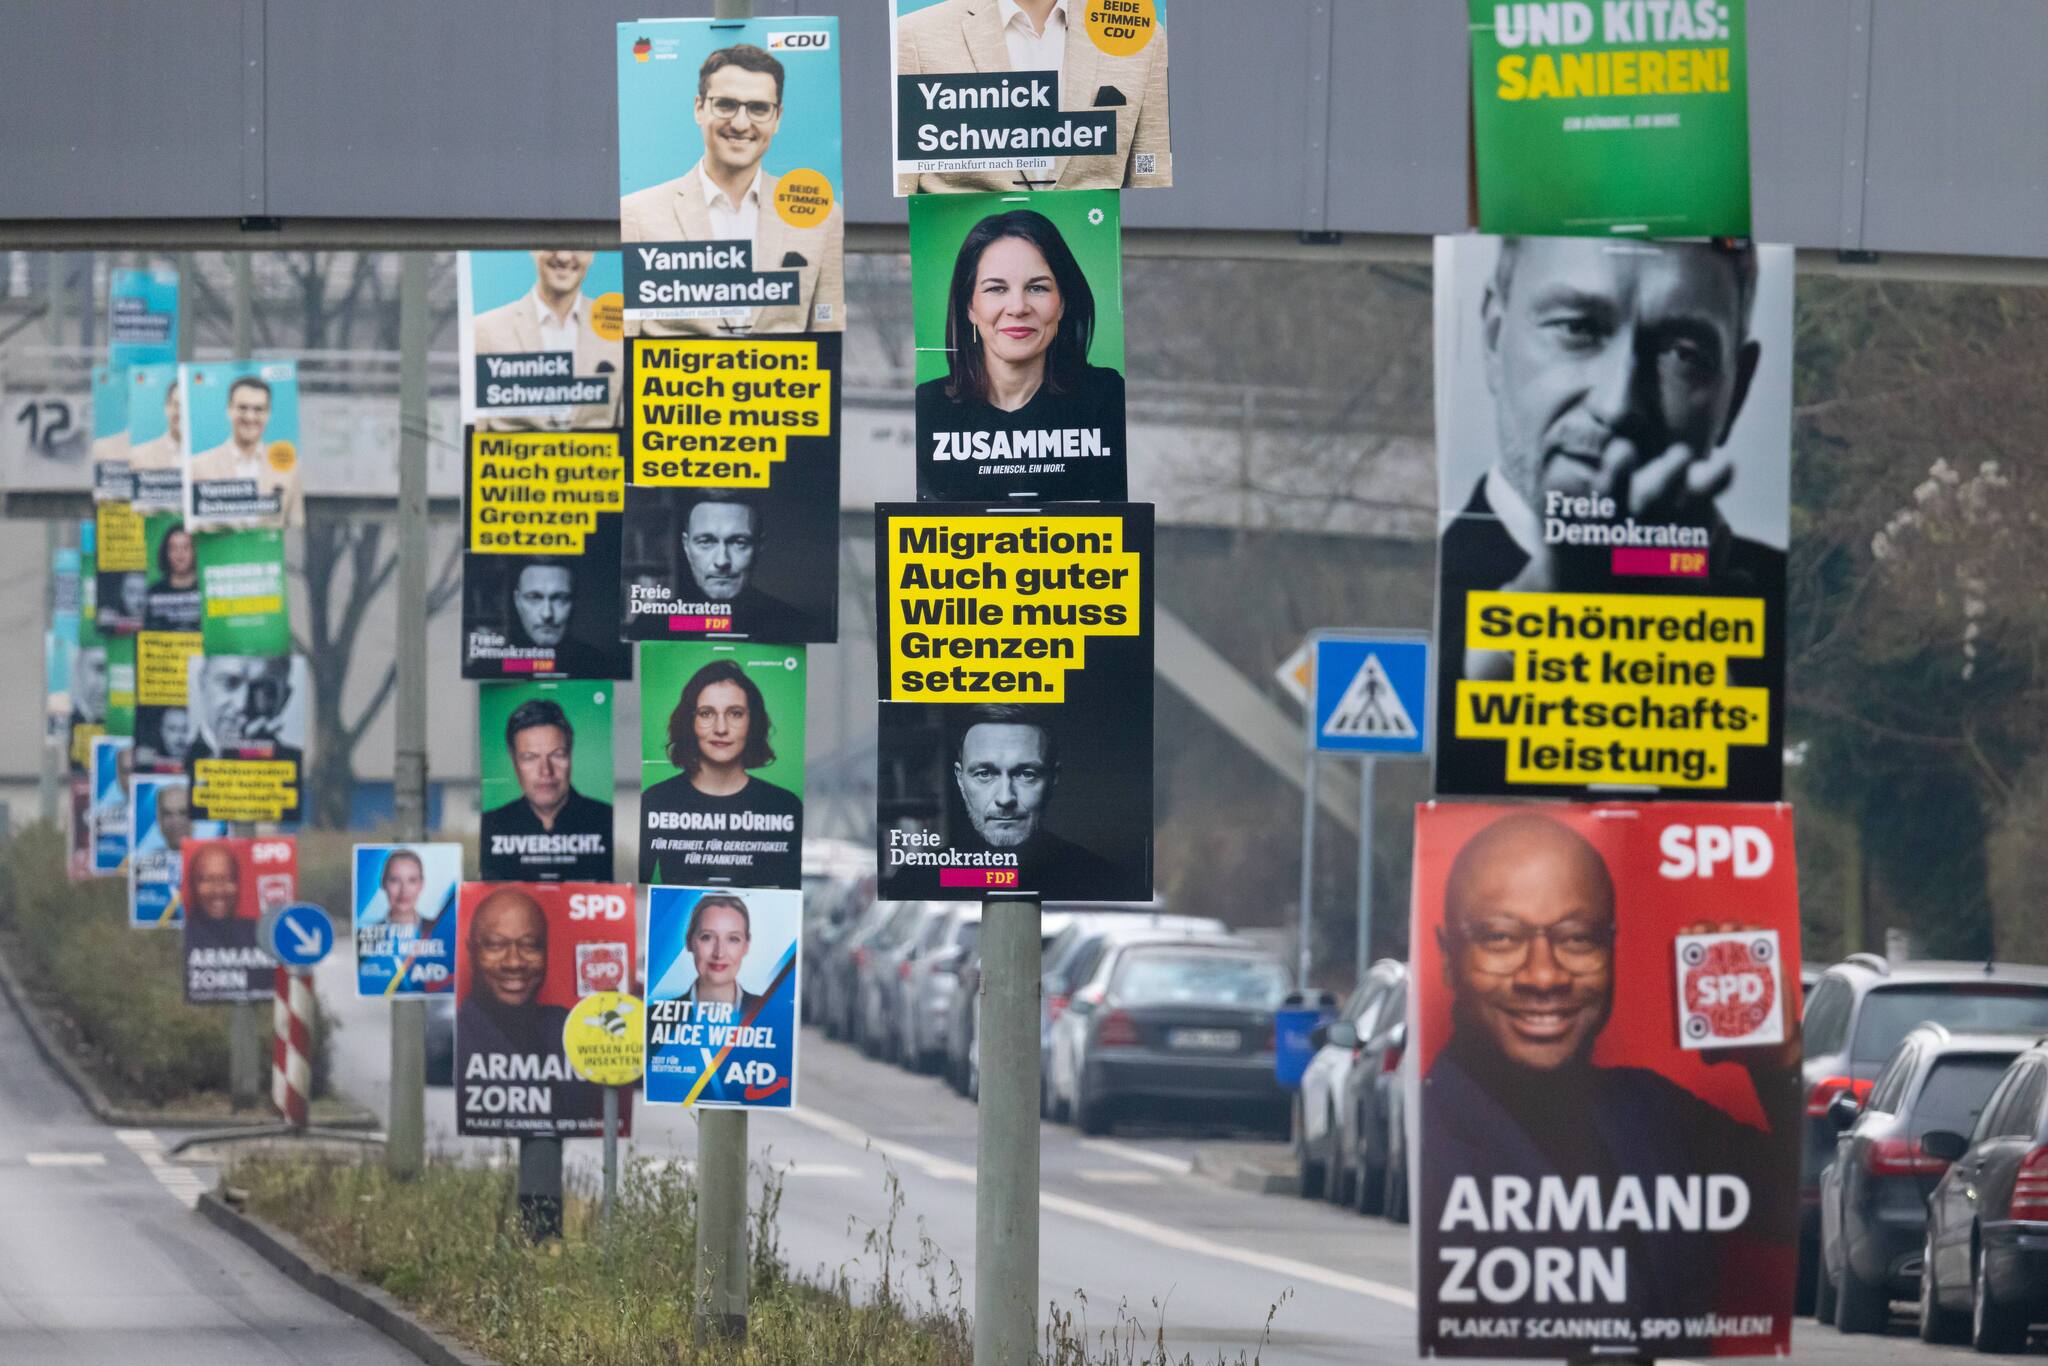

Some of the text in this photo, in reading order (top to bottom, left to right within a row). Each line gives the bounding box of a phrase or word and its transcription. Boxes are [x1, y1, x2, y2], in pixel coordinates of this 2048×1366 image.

[1103, 1, 1140, 13] BEIDE
[1090, 12, 1150, 27] STIMMEN
[1494, 0, 1729, 48] UND KITAS:
[784, 35, 826, 47] CDU
[1104, 27, 1135, 39] CDU
[1497, 48, 1730, 101] SANIEREN!
[917, 79, 1050, 110] Yannick
[917, 120, 1108, 151] Schwander
[917, 158, 1047, 171] Für Frankfurt nach Berlin
[778, 193, 829, 206] STIMMEN
[789, 184, 819, 195] BEIDE
[789, 205, 816, 215] CDU
[638, 245, 746, 271] Yannick
[638, 278, 793, 303] Schwander
[486, 355, 570, 378] Yannick
[642, 348, 809, 374] Migration:
[486, 382, 605, 405] Schwander
[642, 376, 821, 402] Auch guter
[643, 404, 819, 427] Wille muss
[17, 399, 71, 457] 12
[480, 439, 613, 461] Migration:
[642, 431, 777, 452] Grenzen
[933, 428, 1110, 461] ZUSAMMEN.
[481, 463, 621, 483] Auch guter
[642, 457, 761, 478] setzen.
[978, 464, 1066, 475] EIN MENSCH. EIN WORT.
[481, 486, 620, 504] Wille muss
[1545, 491, 1616, 518] Freie
[480, 508, 589, 525] Grenzen
[480, 530, 577, 547] setzen.
[900, 526, 1112, 559] Migration:
[1545, 518, 1709, 546] Demokraten
[1669, 553, 1706, 573] FDP
[900, 562, 1128, 596] Auch guter
[630, 584, 671, 599] Freie
[630, 599, 732, 615] Demokraten
[900, 598, 1127, 625] Wille muss
[705, 618, 729, 629] FDP
[1480, 605, 1754, 643] Schönreden
[470, 645, 555, 659] Demokraten
[900, 632, 1074, 659] Grenzen
[901, 666, 1053, 692] setzen.
[1528, 650, 1715, 686] ist keine
[1470, 693, 1758, 731] Wirtschafts-
[1519, 737, 1717, 781] leistung.
[648, 811, 794, 831] DEBORAH DÜRING
[491, 834, 606, 855] ZUVERSICHT.
[651, 838, 789, 853] FÜR FREIHEIT. FÜR GERECHTIGKEIT.
[890, 829, 941, 846] Freie
[684, 852, 753, 865] FÜR FRANKFURT.
[890, 848, 1018, 866] Demokraten
[1658, 824, 1774, 879] SPD
[985, 872, 1015, 884] FDP
[568, 894, 626, 920] SPD
[586, 963, 618, 978] SPD
[1697, 973, 1764, 1005] SPD
[651, 1000, 733, 1024] ZEIT FÜR
[651, 1024, 776, 1048] ALICE WEIDEL
[577, 1044, 621, 1055] WIESEN
[584, 1056, 640, 1066] INSEKTEN
[724, 1061, 776, 1085] AfD
[464, 1086, 552, 1113] ZORN
[1439, 1173, 1751, 1231] ARMAND
[1439, 1246, 1627, 1303] ZORN
[1438, 1312, 1774, 1341] PLAKAT SCANNEN, SPD WÄHLEN!
